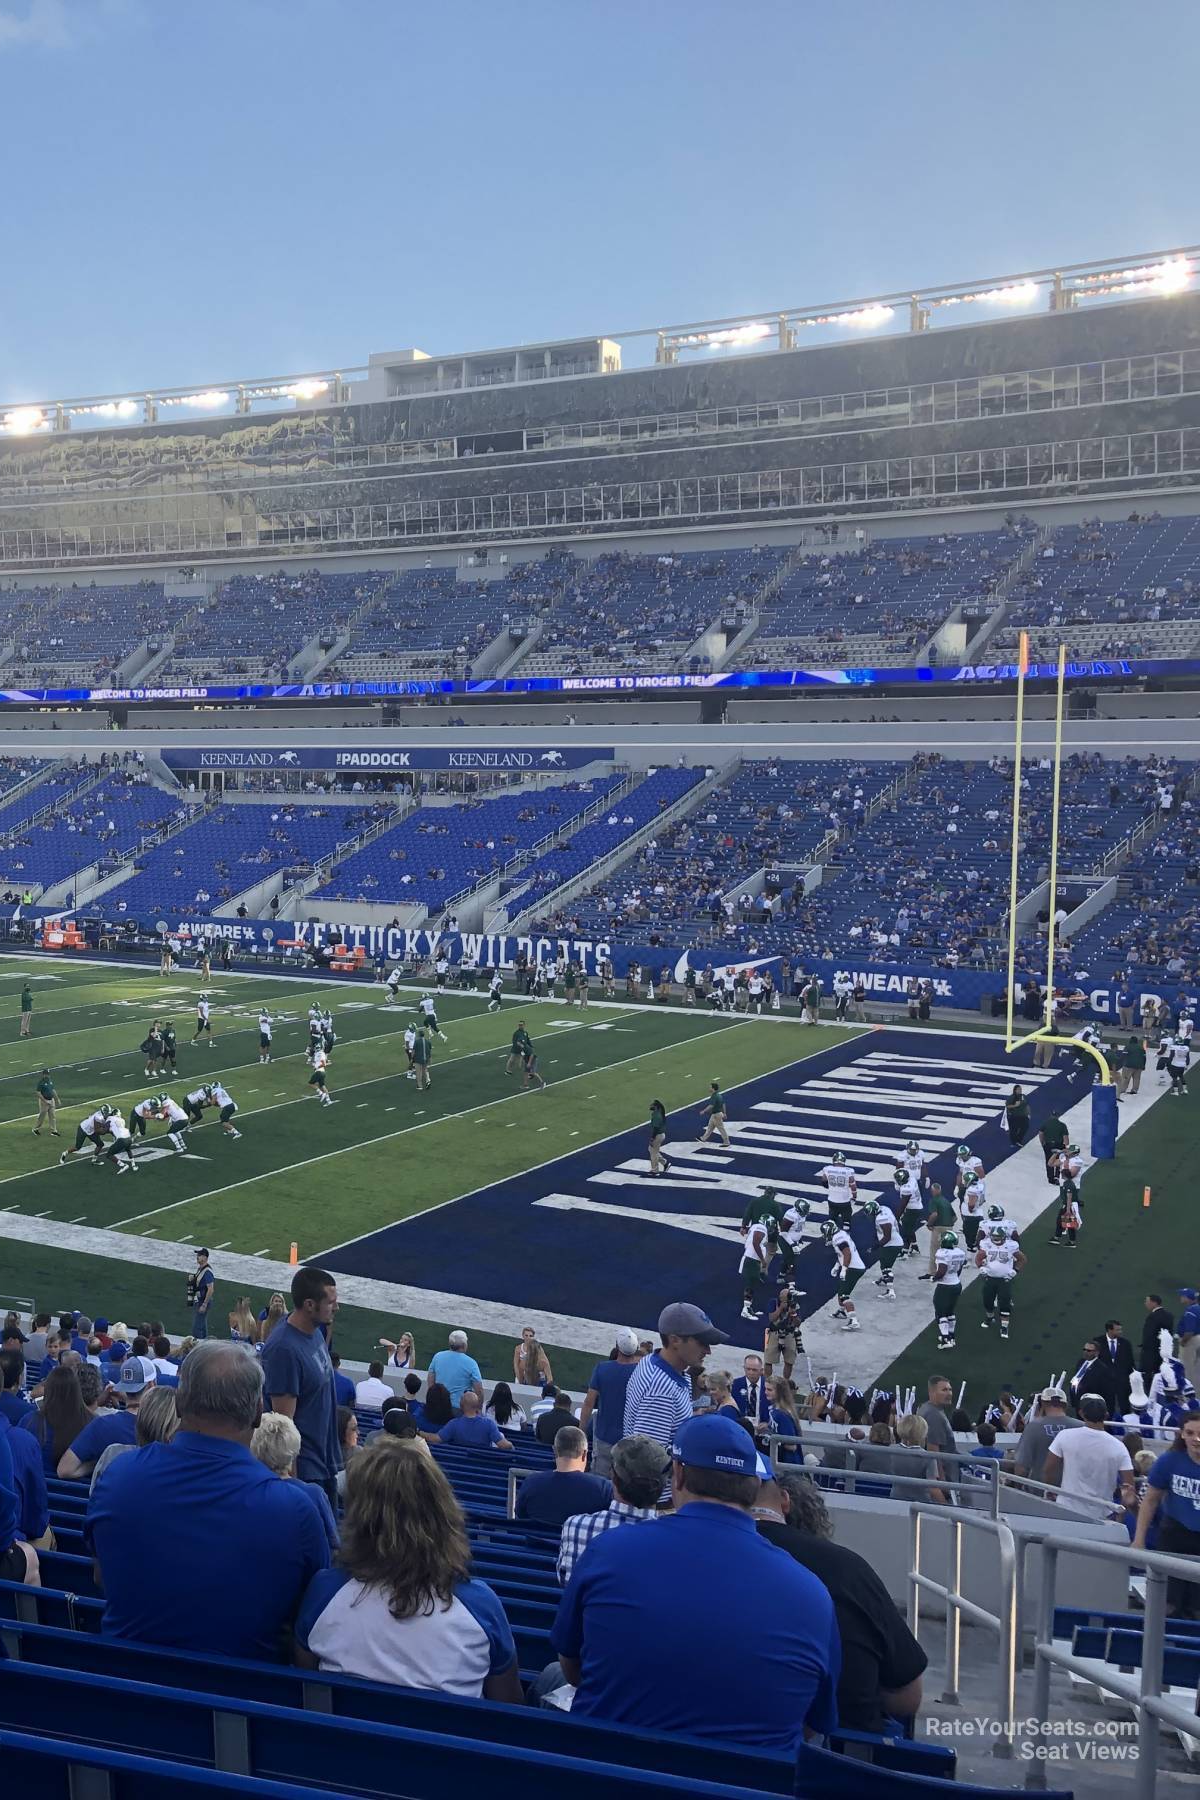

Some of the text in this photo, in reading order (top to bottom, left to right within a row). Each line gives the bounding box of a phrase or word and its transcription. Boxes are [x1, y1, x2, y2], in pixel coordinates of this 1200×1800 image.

[562, 678, 617, 689] WELCOME
[618, 677, 634, 688] TO
[635, 676, 682, 687] KROGER
[90, 688, 208, 699] WELCOME TO KROGER FIELD
[200, 752, 274, 766] KEENELAND
[341, 752, 410, 766] PADDOCK
[448, 752, 533, 766] KEENELAND
[770, 873, 780, 882] 24
[1056, 886, 1067, 896] 23
[715, 1455, 745, 1468] KENTUCKY
